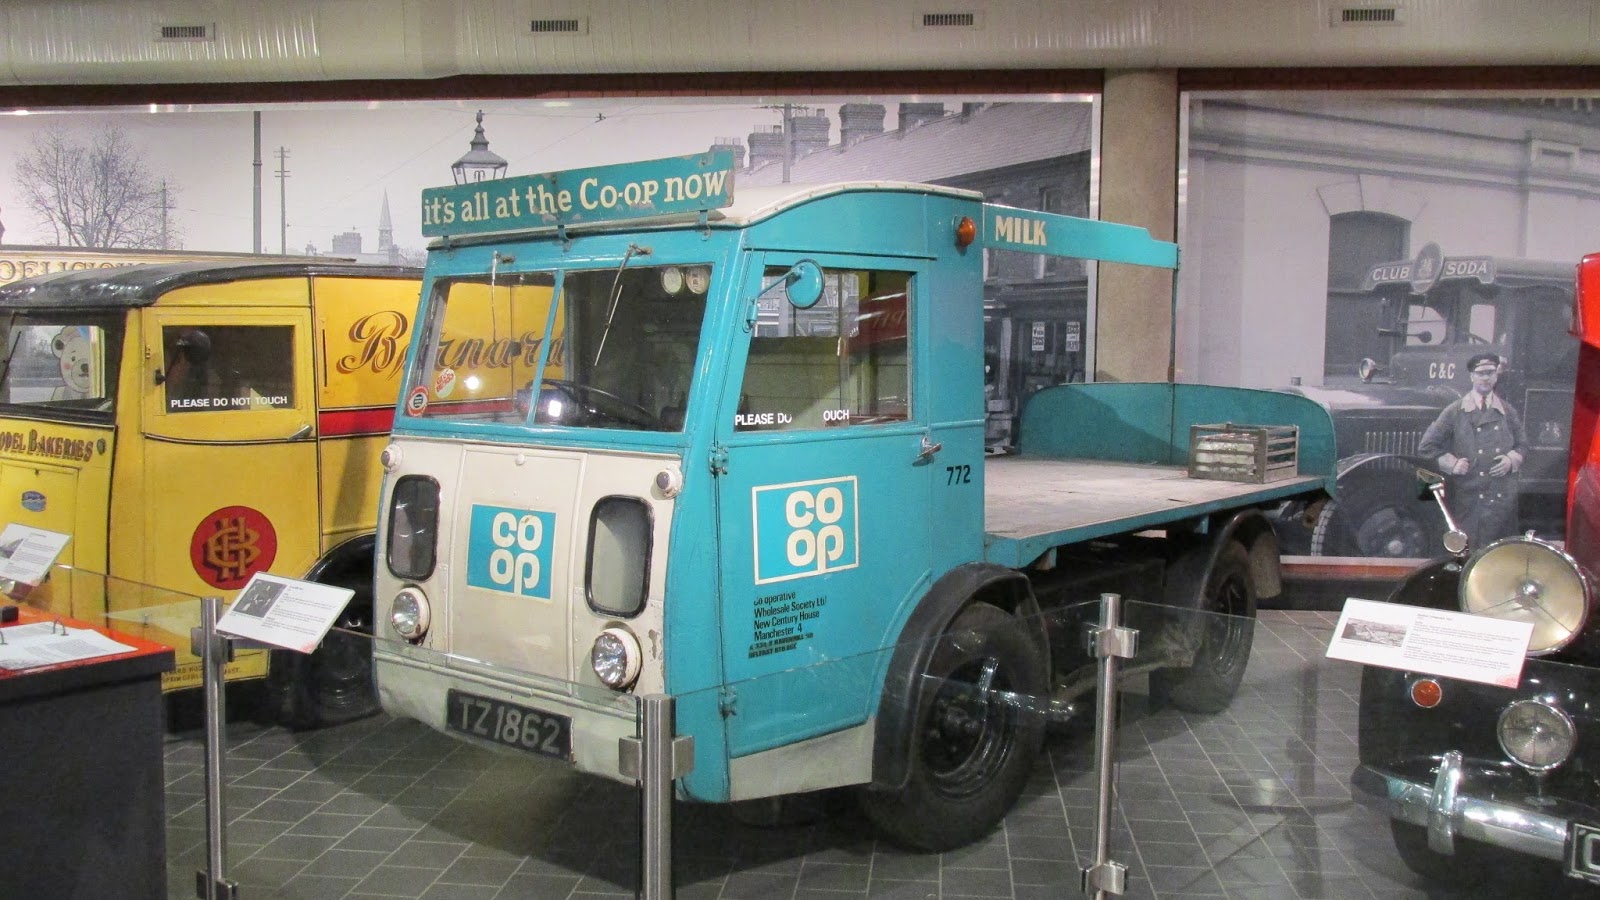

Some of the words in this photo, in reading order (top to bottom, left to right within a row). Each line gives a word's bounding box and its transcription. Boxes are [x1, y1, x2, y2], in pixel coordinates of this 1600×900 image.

[424, 196, 455, 225] it's
[461, 192, 490, 222] all
[496, 188, 520, 218] at
[526, 184, 572, 215] the
[664, 169, 730, 203] now
[995, 215, 1047, 246] MILK
[1372, 264, 1411, 282] CLUB
[1445, 260, 1488, 276] SODA
[171, 398, 210, 408] PLEASE
[213, 398, 229, 407] DO
[231, 397, 251, 406] NOT
[254, 396, 288, 405] TOUCH
[734, 412, 774, 426] PLEASE
[946, 464, 971, 486] 772
[754, 604, 790, 619] Wholesale
[791, 600, 816, 612] Society
[754, 619, 771, 630] New
[771, 614, 799, 627] Century
[799, 610, 820, 621] House
[754, 627, 794, 641] Manchester
